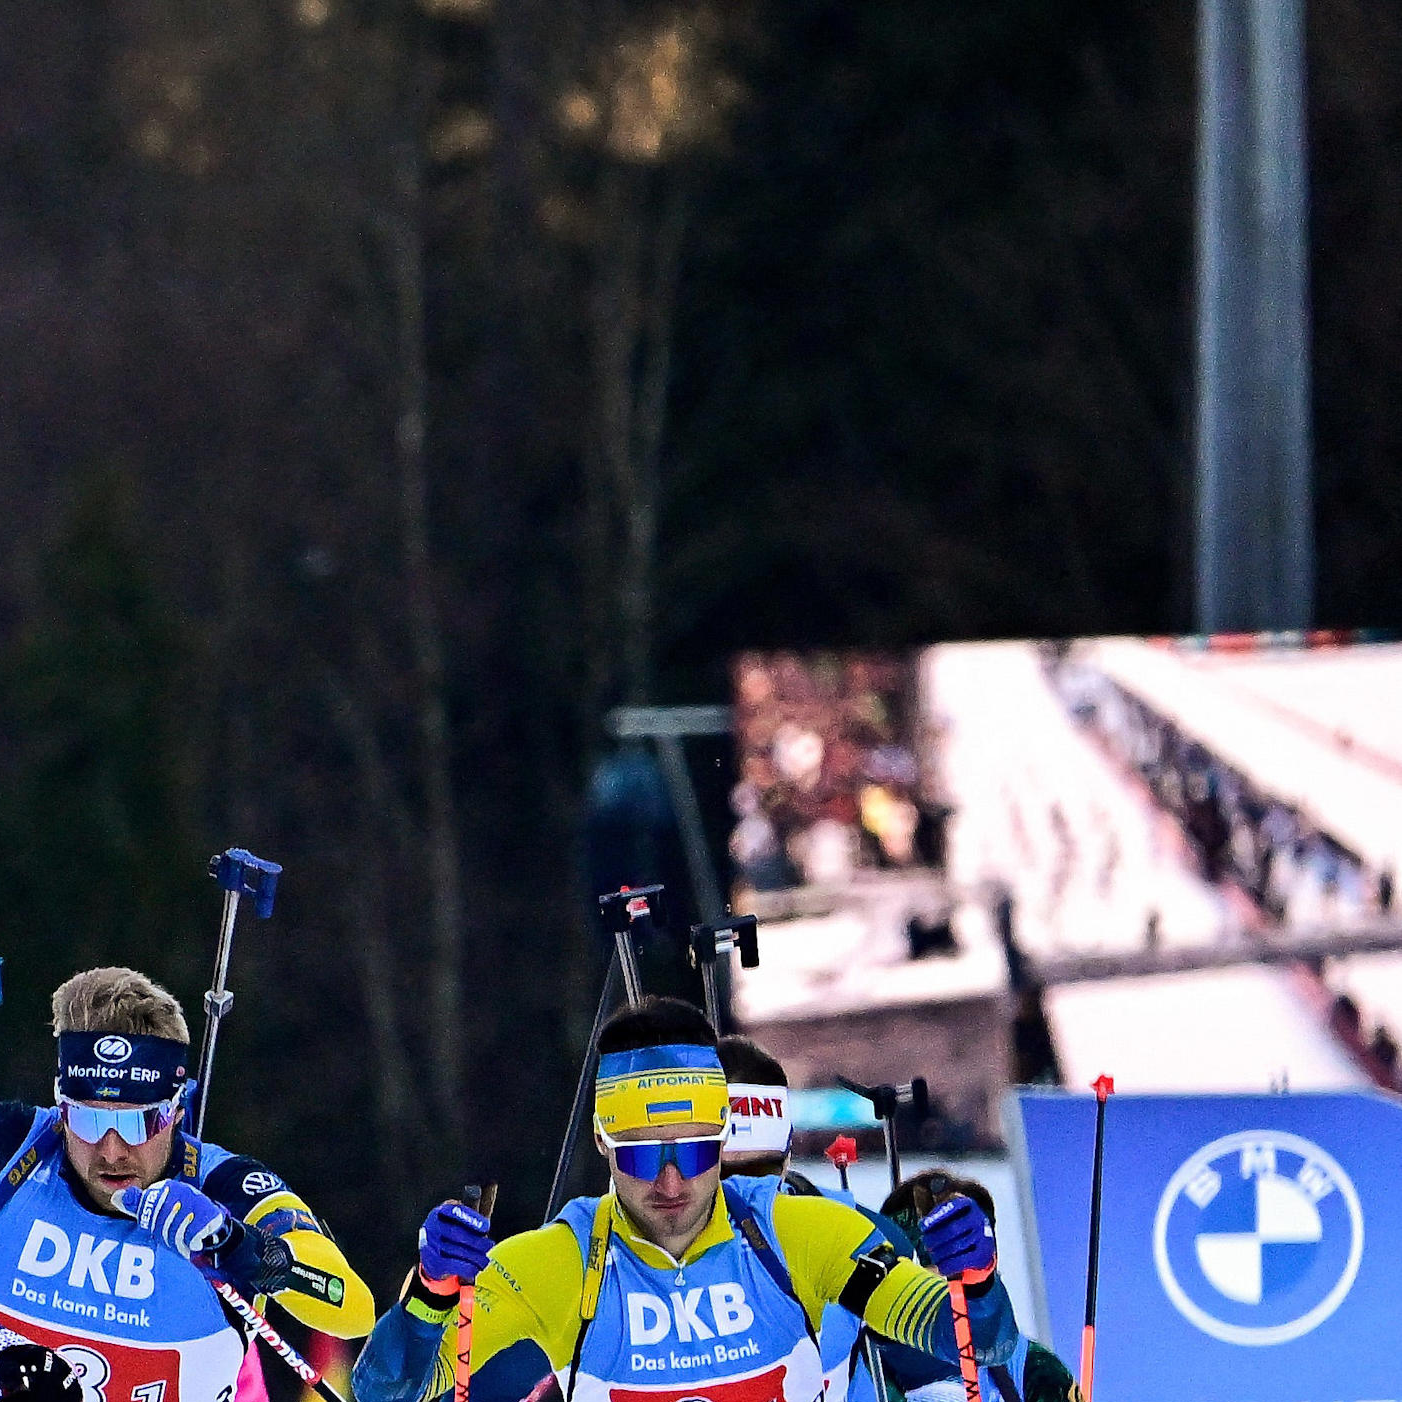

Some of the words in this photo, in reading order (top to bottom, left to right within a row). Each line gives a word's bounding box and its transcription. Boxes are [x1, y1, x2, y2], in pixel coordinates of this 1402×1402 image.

[68, 1064, 127, 1081] Monitor
[131, 1067, 161, 1083] ERP
[18, 1219, 155, 1300] DKB
[11, 1279, 46, 1306] Das
[51, 1293, 98, 1319] kann
[104, 1304, 150, 1328] Bank
[628, 1282, 755, 1346] DKB
[221, 1283, 317, 1381] SALOMON
[632, 1350, 666, 1372] Das
[671, 1346, 710, 1368] kann
[715, 1340, 760, 1364] Bank
